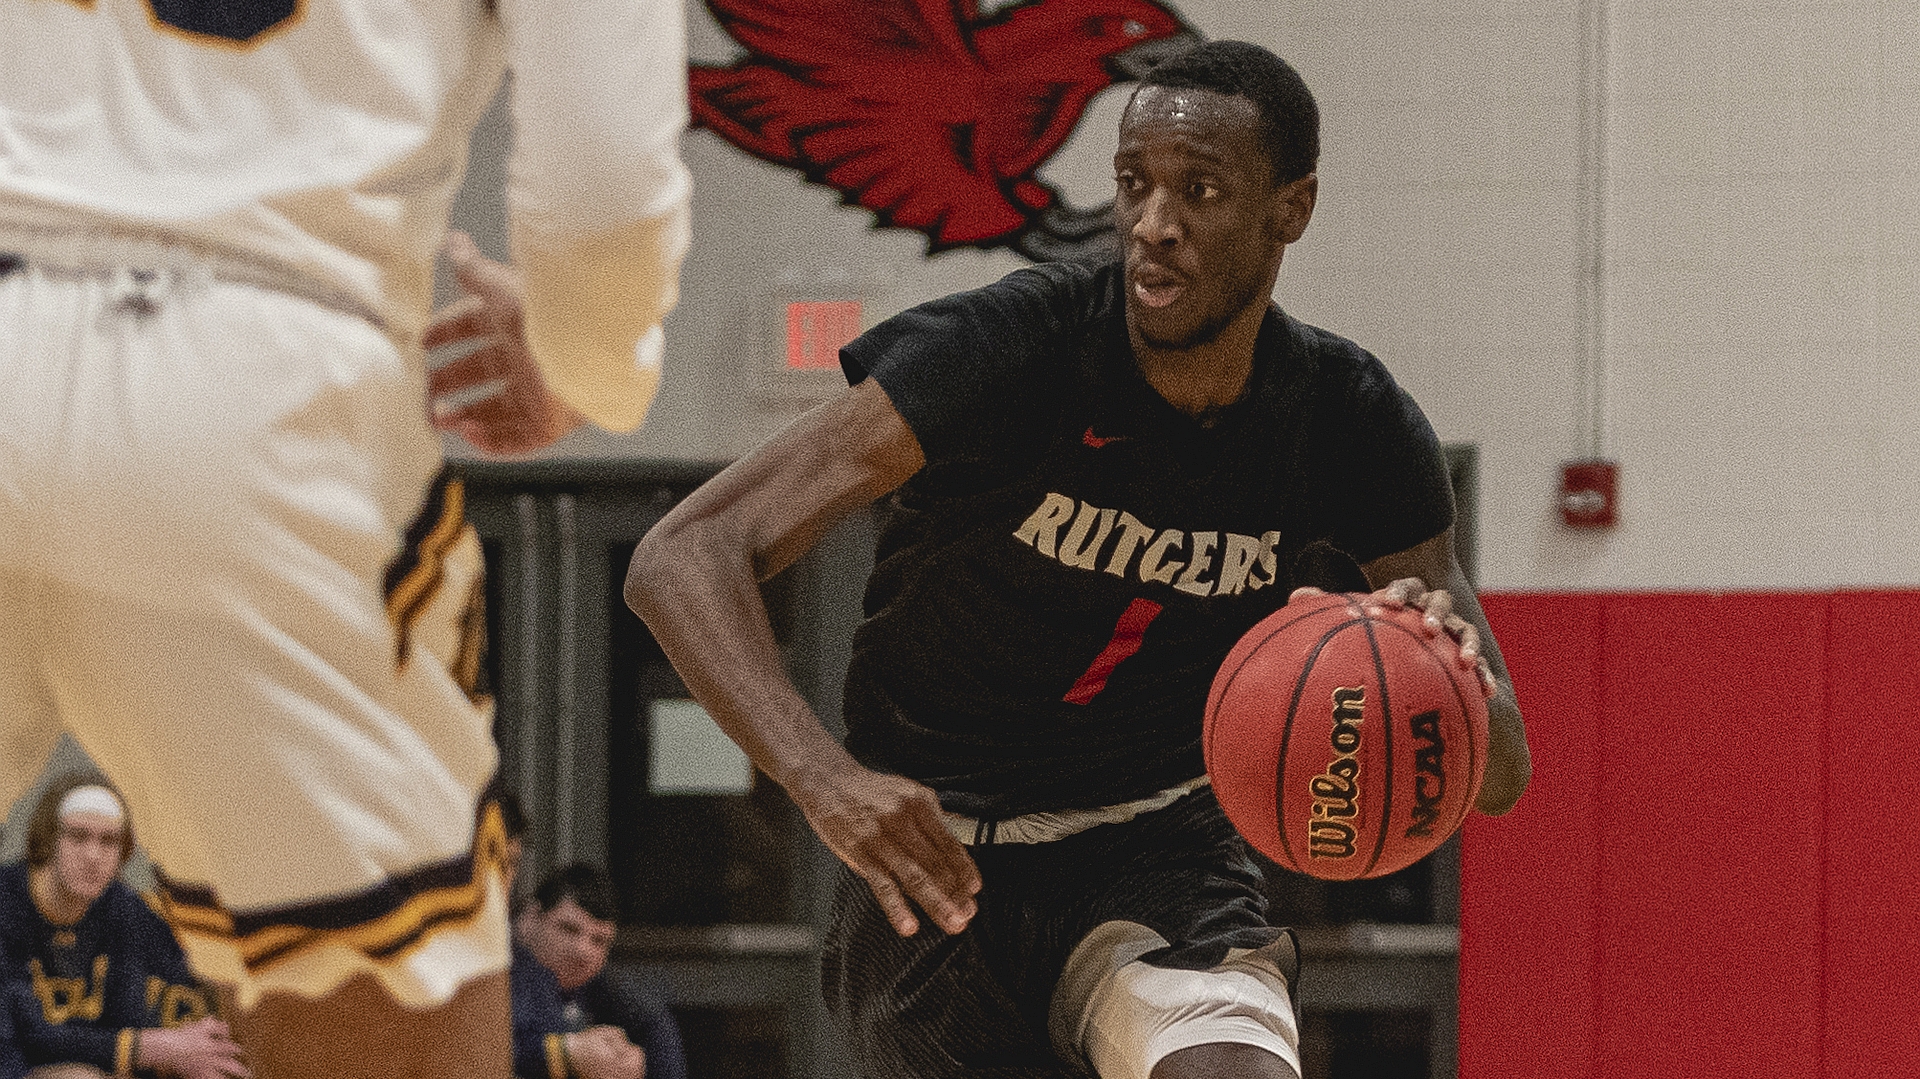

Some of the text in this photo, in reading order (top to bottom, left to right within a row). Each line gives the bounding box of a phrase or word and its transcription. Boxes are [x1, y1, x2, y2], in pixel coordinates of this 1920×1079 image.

[1013, 492, 1282, 597] RUTGERS
[1063, 598, 1163, 705] 1
[1308, 684, 1367, 861] Wilson
[1405, 709, 1446, 840] NCAA
